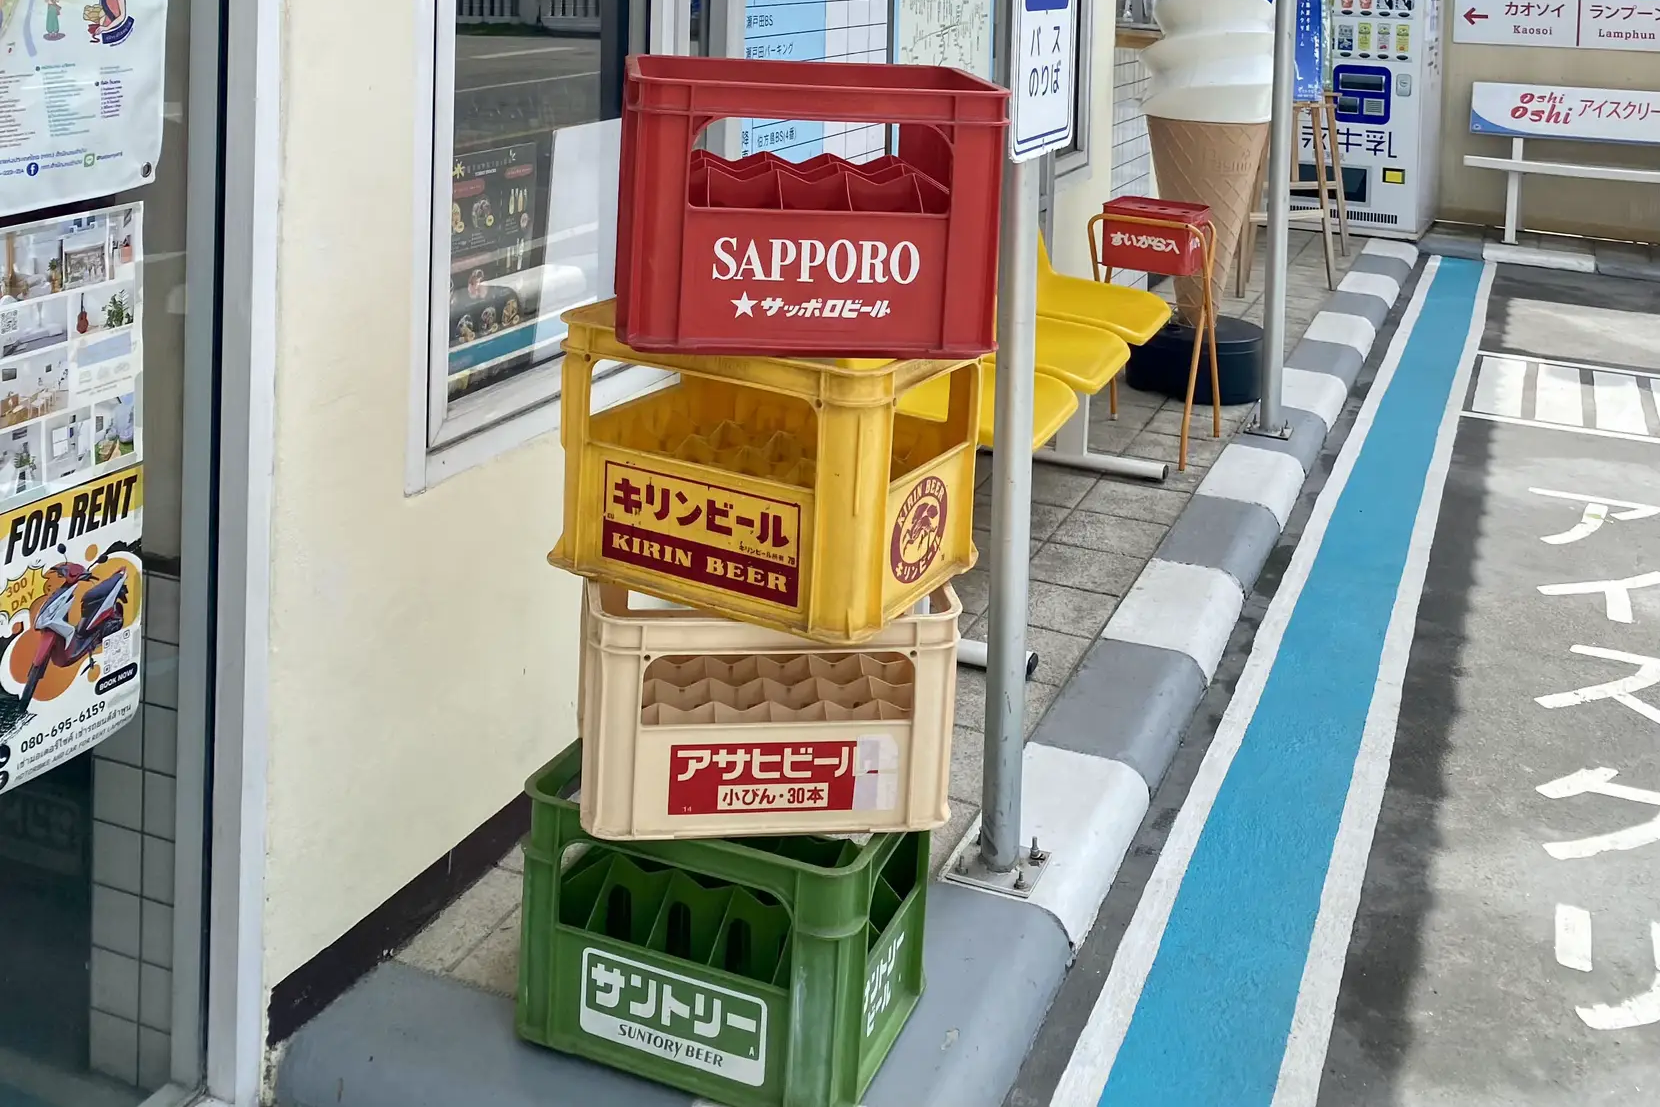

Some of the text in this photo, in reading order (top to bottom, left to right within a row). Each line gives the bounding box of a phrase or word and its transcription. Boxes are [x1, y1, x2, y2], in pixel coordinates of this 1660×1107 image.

[1504, 1, 1566, 18] カオソイ
[1030, 25, 1061, 57] バス
[1512, 25, 1656, 40] Kaosoi Lamphun
[1028, 60, 1062, 98] のりば
[712, 236, 920, 285] SAPPORO
[1110, 232, 1180, 255] すいがら入
[760, 296, 891, 319] サッポロビール
[4, 474, 139, 565] FOR RENT
[612, 477, 790, 548] キリンビール
[897, 479, 945, 528] KIRIN BEER
[612, 532, 788, 593] KIRIN BEER
[6, 576, 28, 598] 300
[11, 588, 35, 612] DAY
[99, 668, 135, 691] BOOK NOW
[20, 700, 106, 753] 080-695-6159
[682, 805, 692, 813] 14
[591, 962, 757, 1039] サントリー
[866, 980, 892, 1038] ビール
[617, 1023, 724, 1068] SUNTORY BEER
[748, 1045, 755, 1057] A
